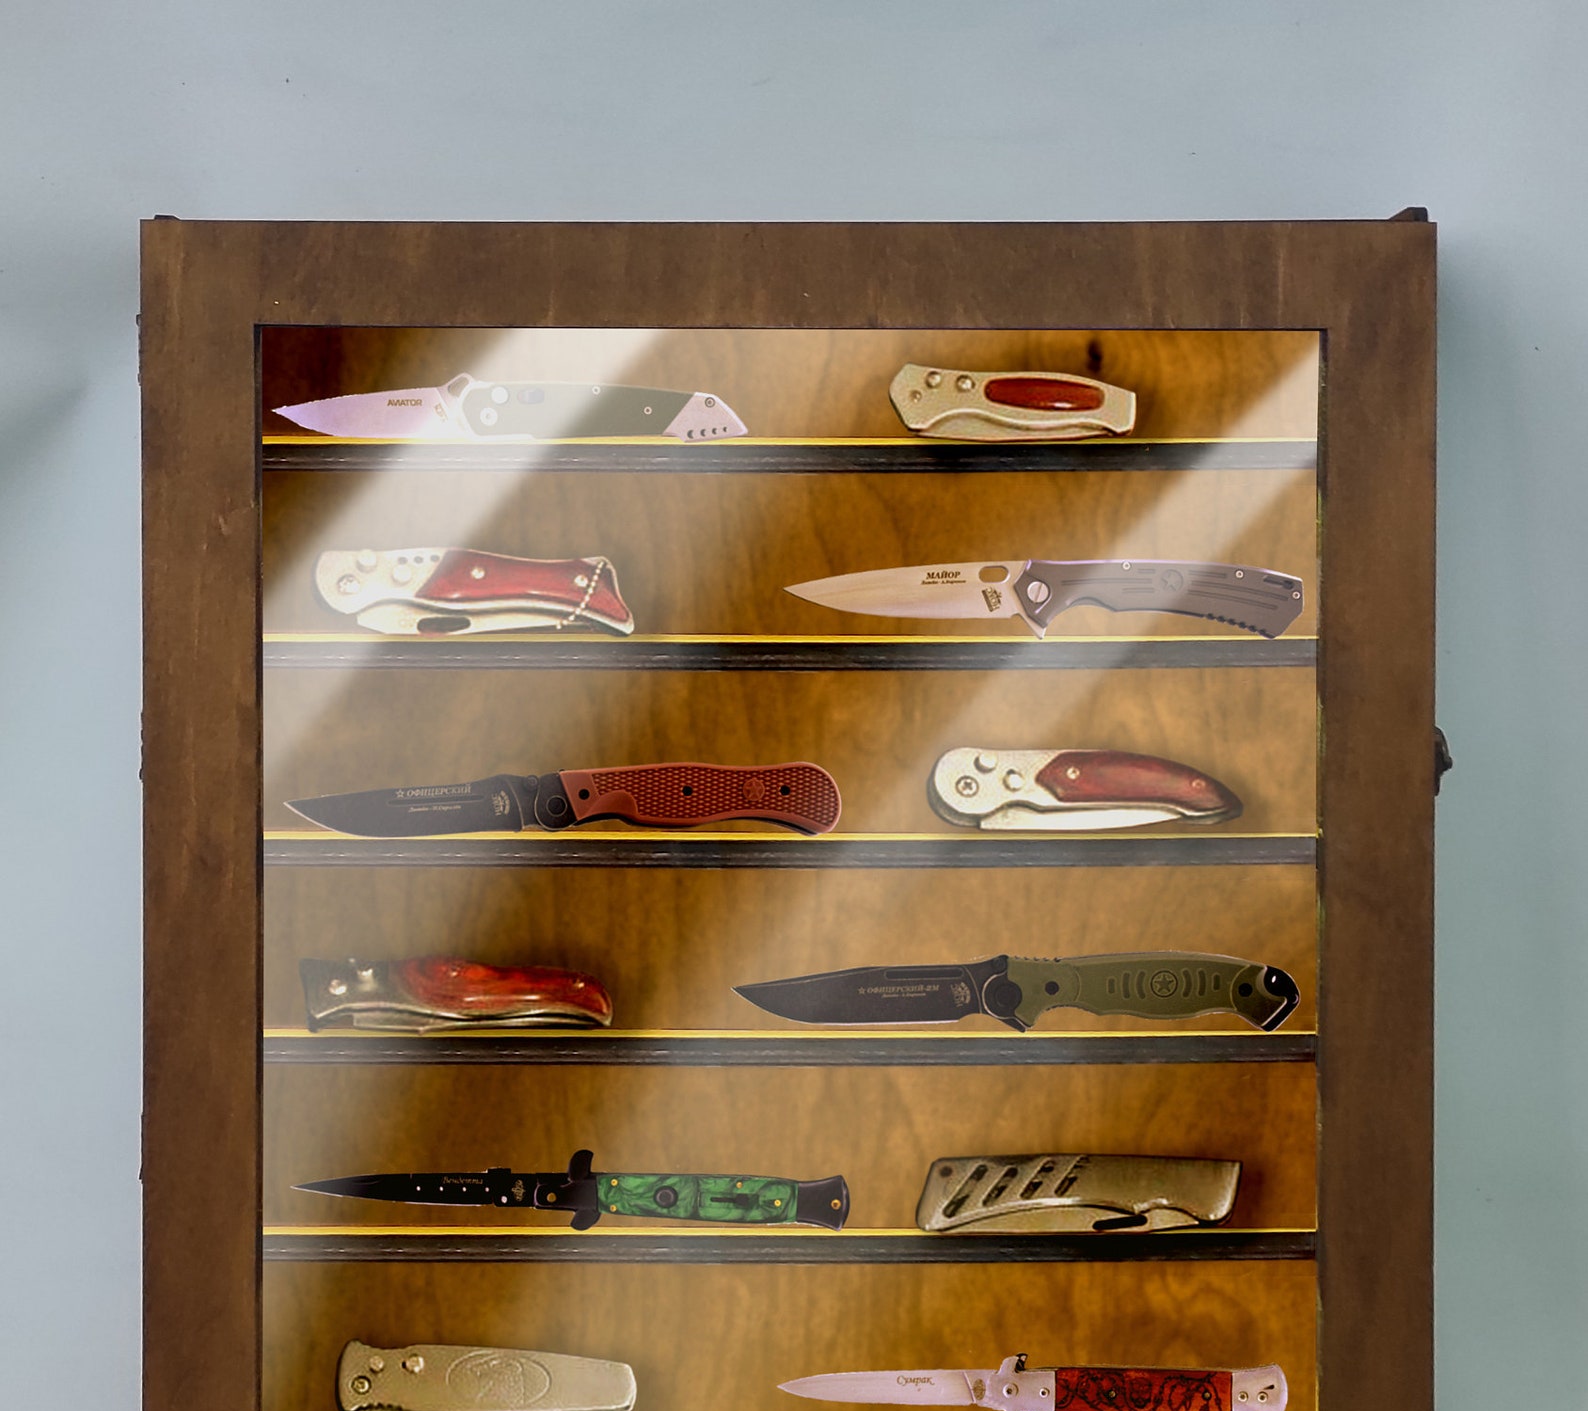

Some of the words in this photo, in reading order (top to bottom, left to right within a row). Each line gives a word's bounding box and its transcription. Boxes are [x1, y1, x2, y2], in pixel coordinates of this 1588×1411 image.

[387, 398, 423, 407] AVIATOR
[926, 570, 961, 580] МАЙОР
[406, 783, 472, 797] ОФИЦЕРСКИЙ
